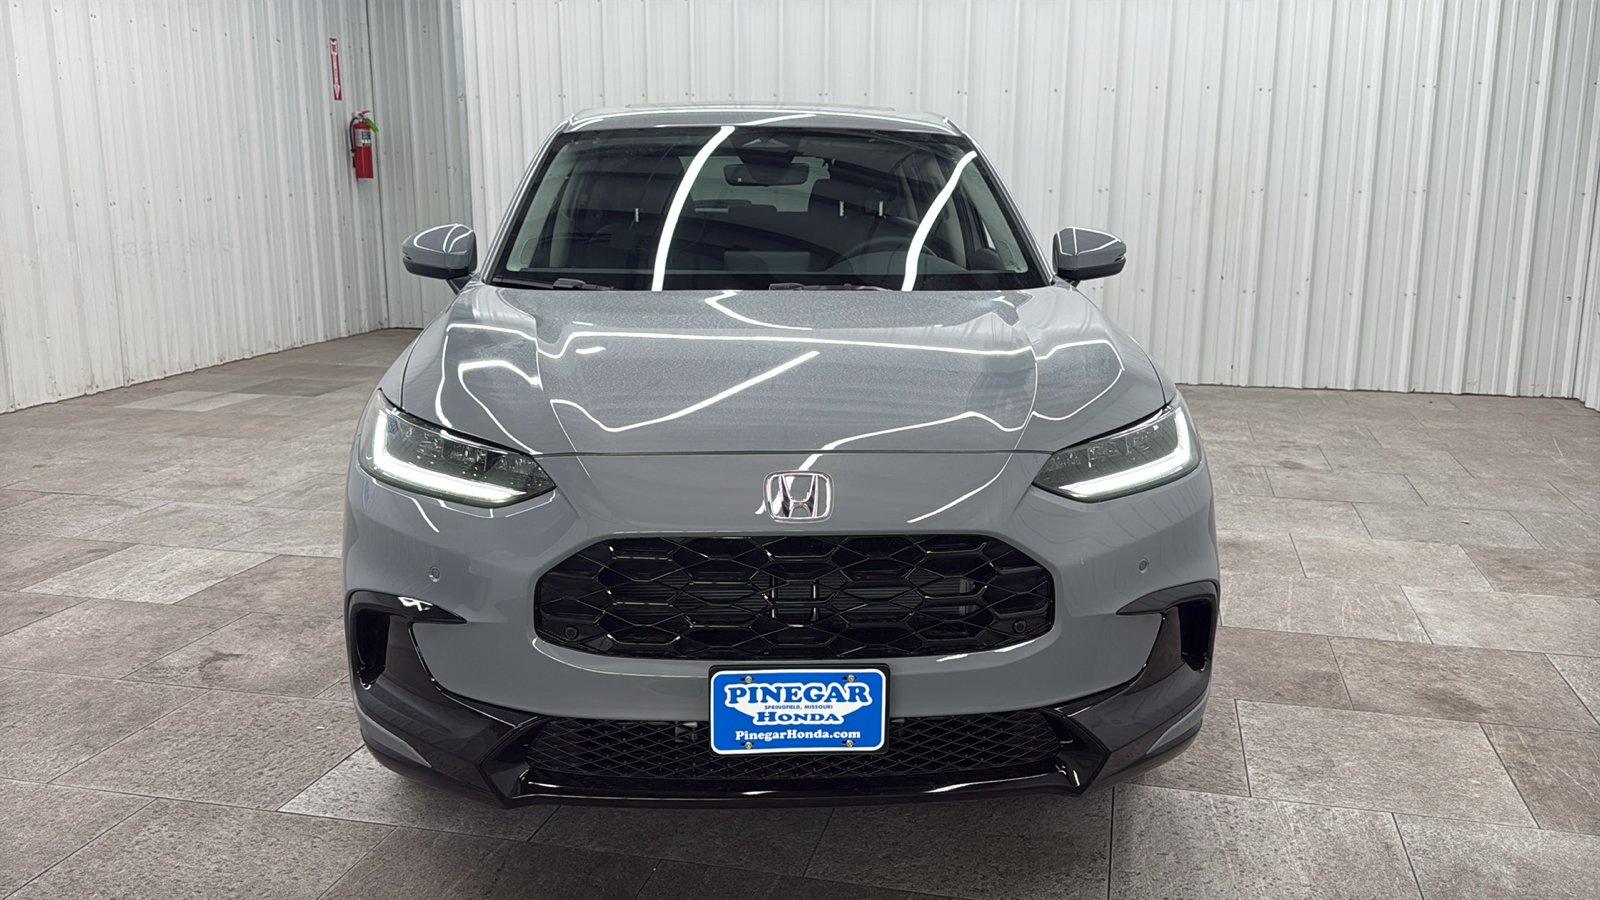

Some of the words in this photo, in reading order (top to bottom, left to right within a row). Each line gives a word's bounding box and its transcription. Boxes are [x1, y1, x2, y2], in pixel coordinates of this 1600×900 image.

[728, 685, 869, 704] PINEGAR
[756, 711, 841, 723] HONDA
[735, 729, 861, 741] PinegarHonda.com
